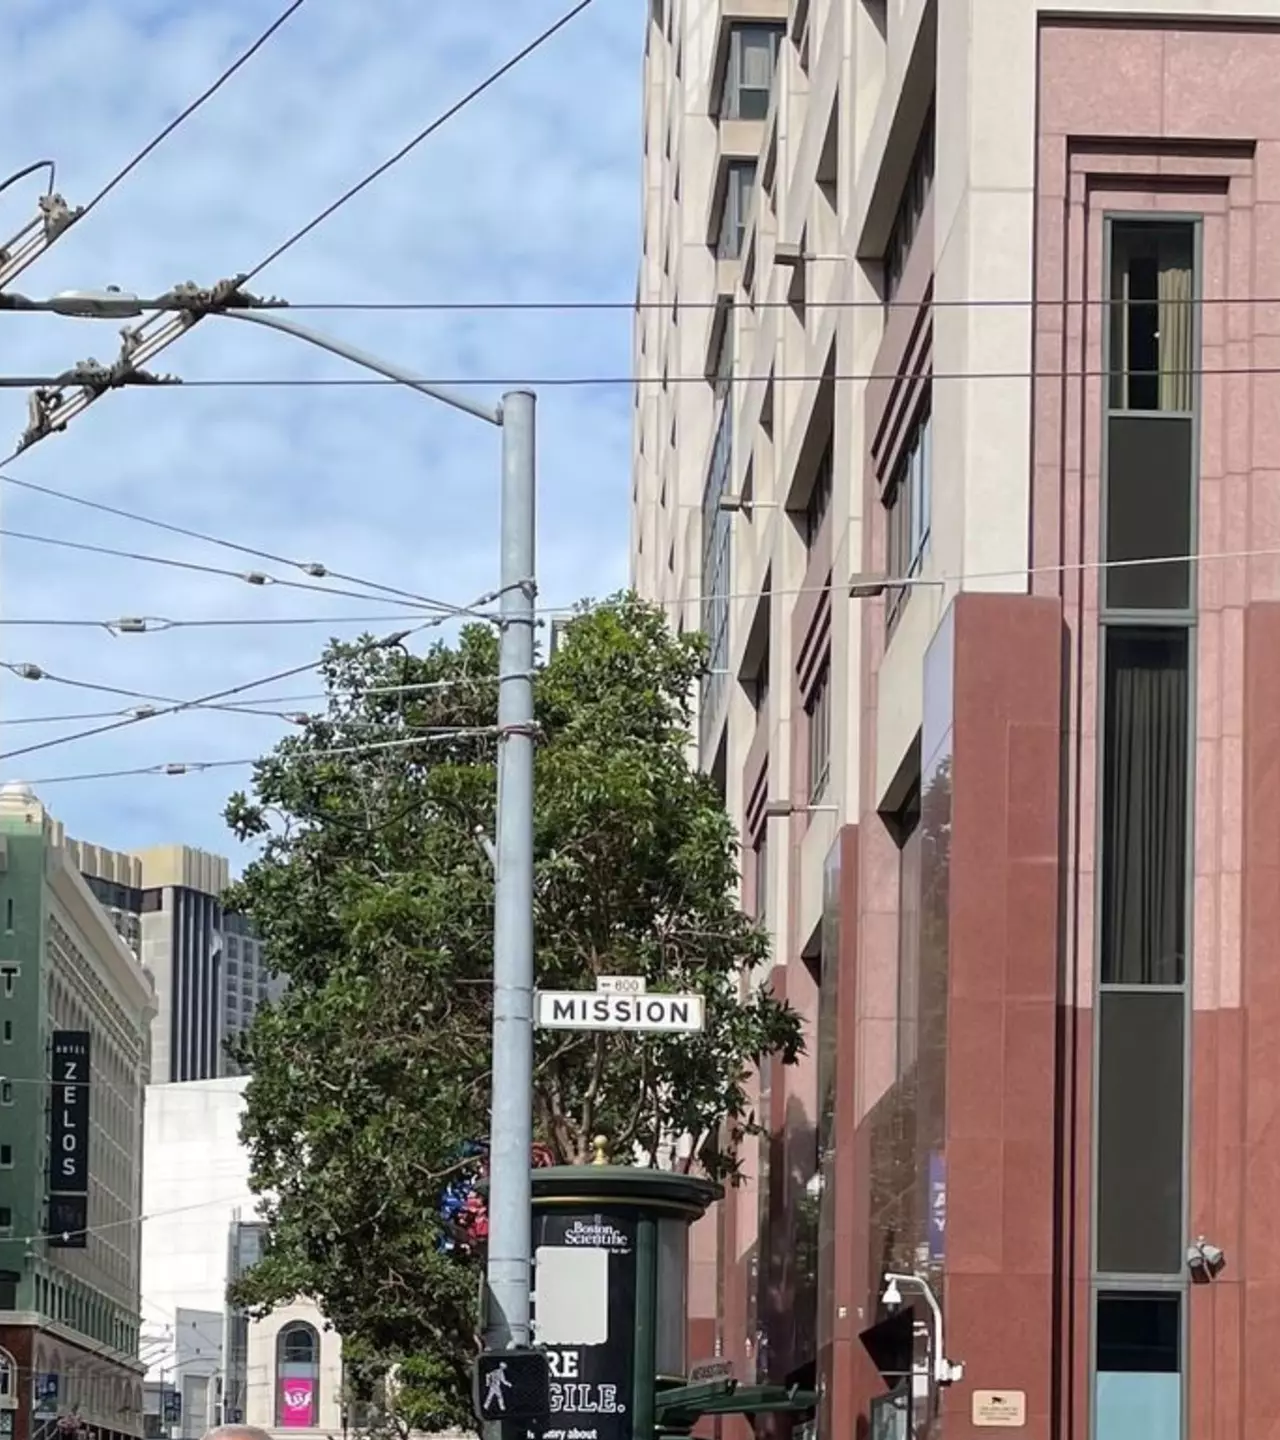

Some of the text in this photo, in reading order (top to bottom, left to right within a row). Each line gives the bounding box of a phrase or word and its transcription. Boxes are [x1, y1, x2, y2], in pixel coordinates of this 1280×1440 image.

[553, 999, 688, 1023] MISSION
[62, 1061, 78, 1176] ZELOS
[565, 1227, 628, 1247] Scientific
[573, 1221, 614, 1234] Boston
[549, 1383, 626, 1413] GILE.
[567, 1428, 597, 1440] about
